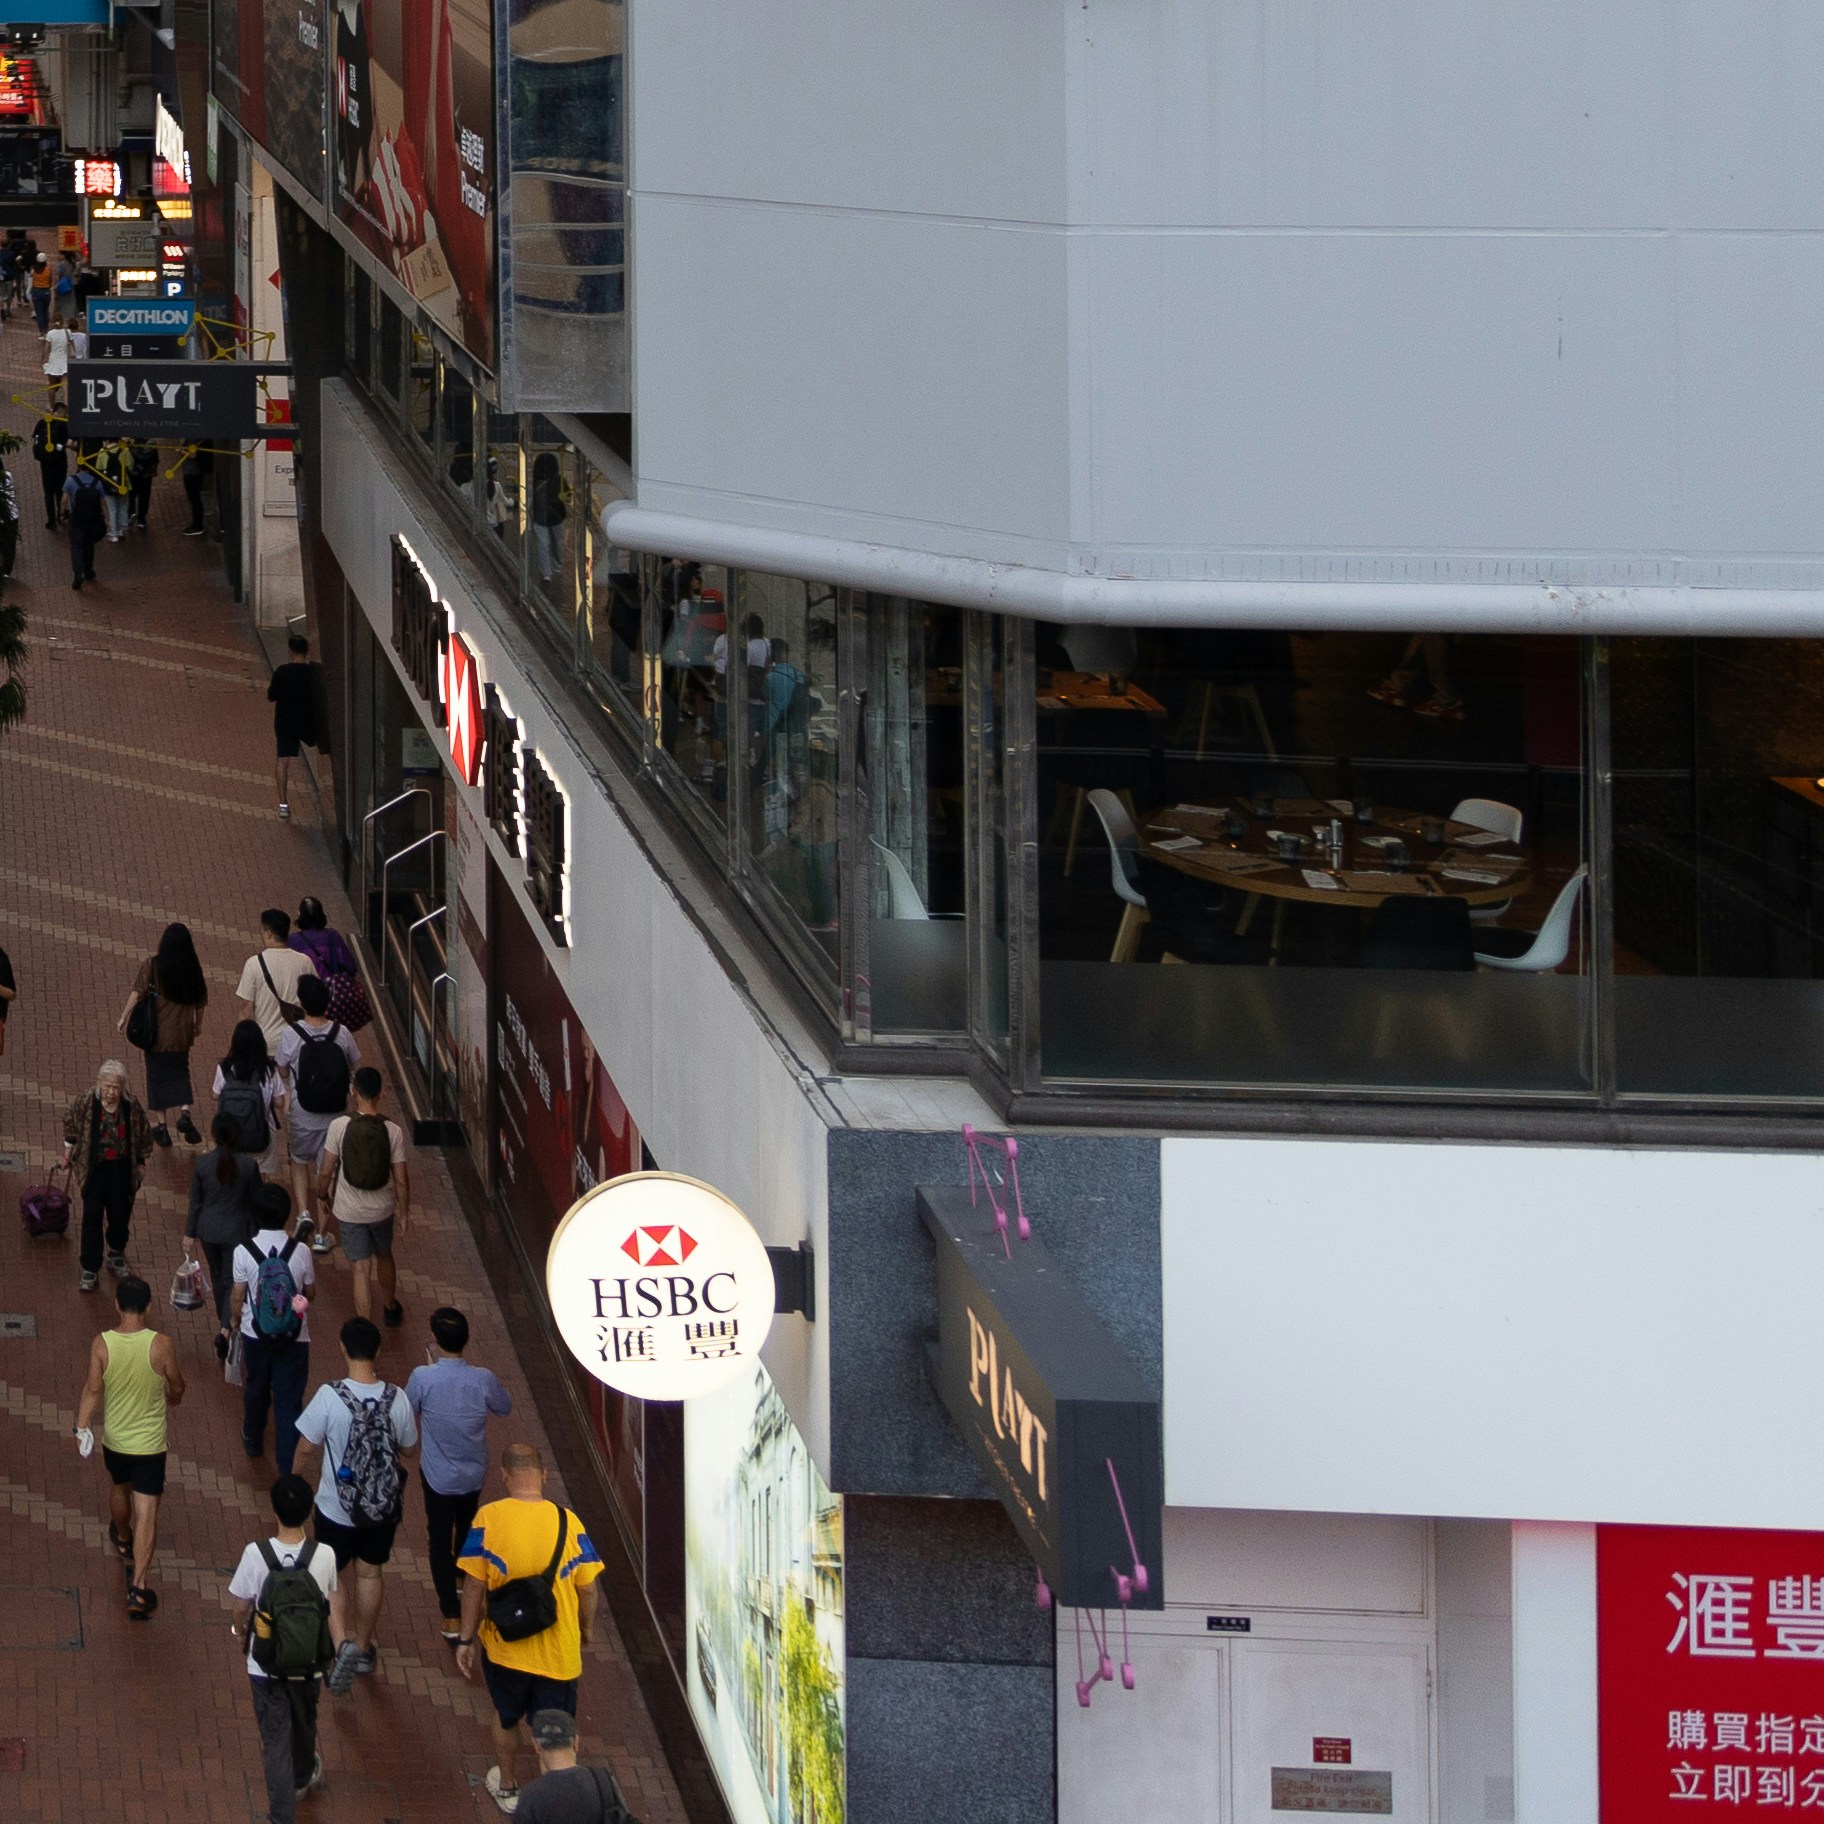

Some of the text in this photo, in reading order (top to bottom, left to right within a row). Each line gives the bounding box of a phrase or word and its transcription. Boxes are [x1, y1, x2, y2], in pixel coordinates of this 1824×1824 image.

[168, 282, 181, 296] P
[95, 308, 188, 325] DECATHLON
[589, 1273, 738, 1318] HSBC
